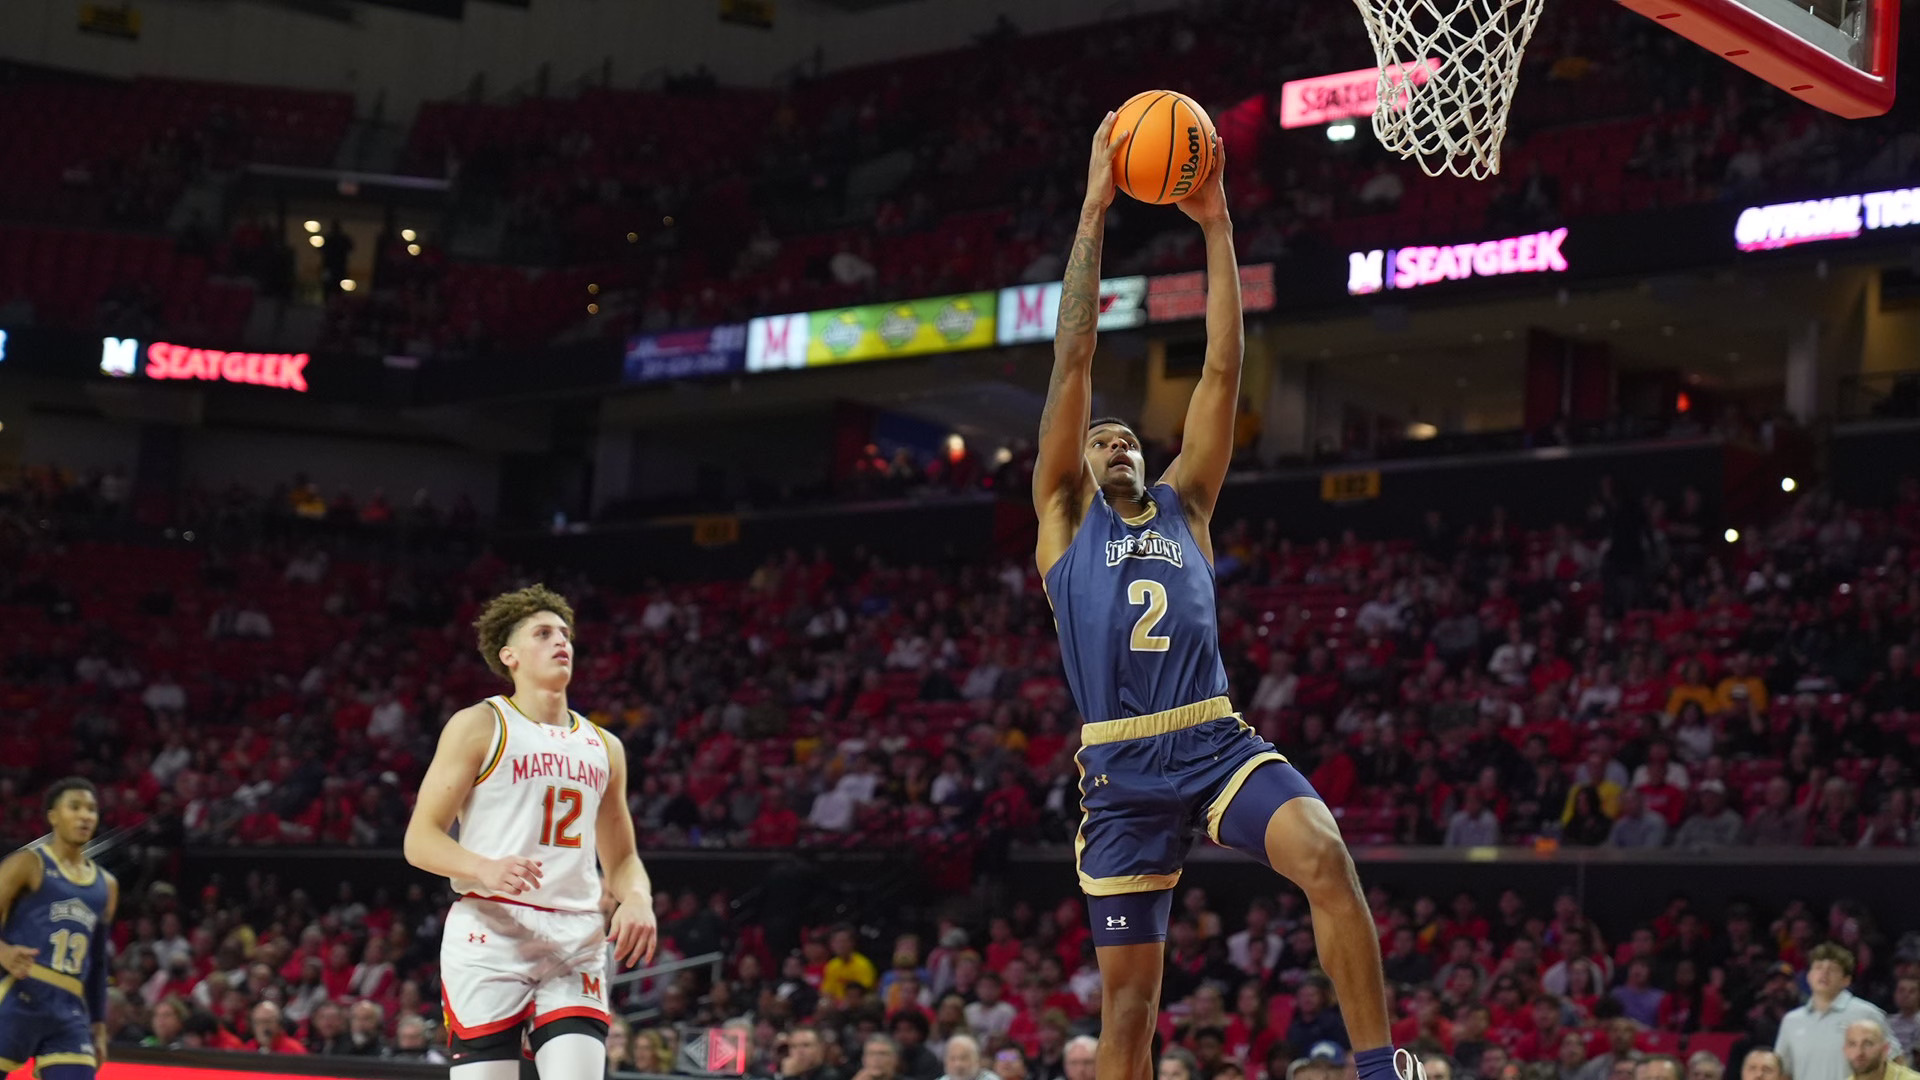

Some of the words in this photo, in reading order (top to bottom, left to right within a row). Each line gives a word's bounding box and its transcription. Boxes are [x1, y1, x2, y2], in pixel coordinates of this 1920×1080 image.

[1168, 126, 1200, 198] Wilson
[1394, 227, 1568, 289] SEATGEEK
[1016, 288, 1045, 330] M
[145, 341, 310, 392] SEATGEEK
[1107, 539, 1137, 562] THE
[1136, 537, 1182, 563] MOUNT
[1127, 579, 1170, 652] 2
[539, 785, 583, 848] 12
[49, 928, 88, 975] 13
[580, 972, 601, 1000] M
